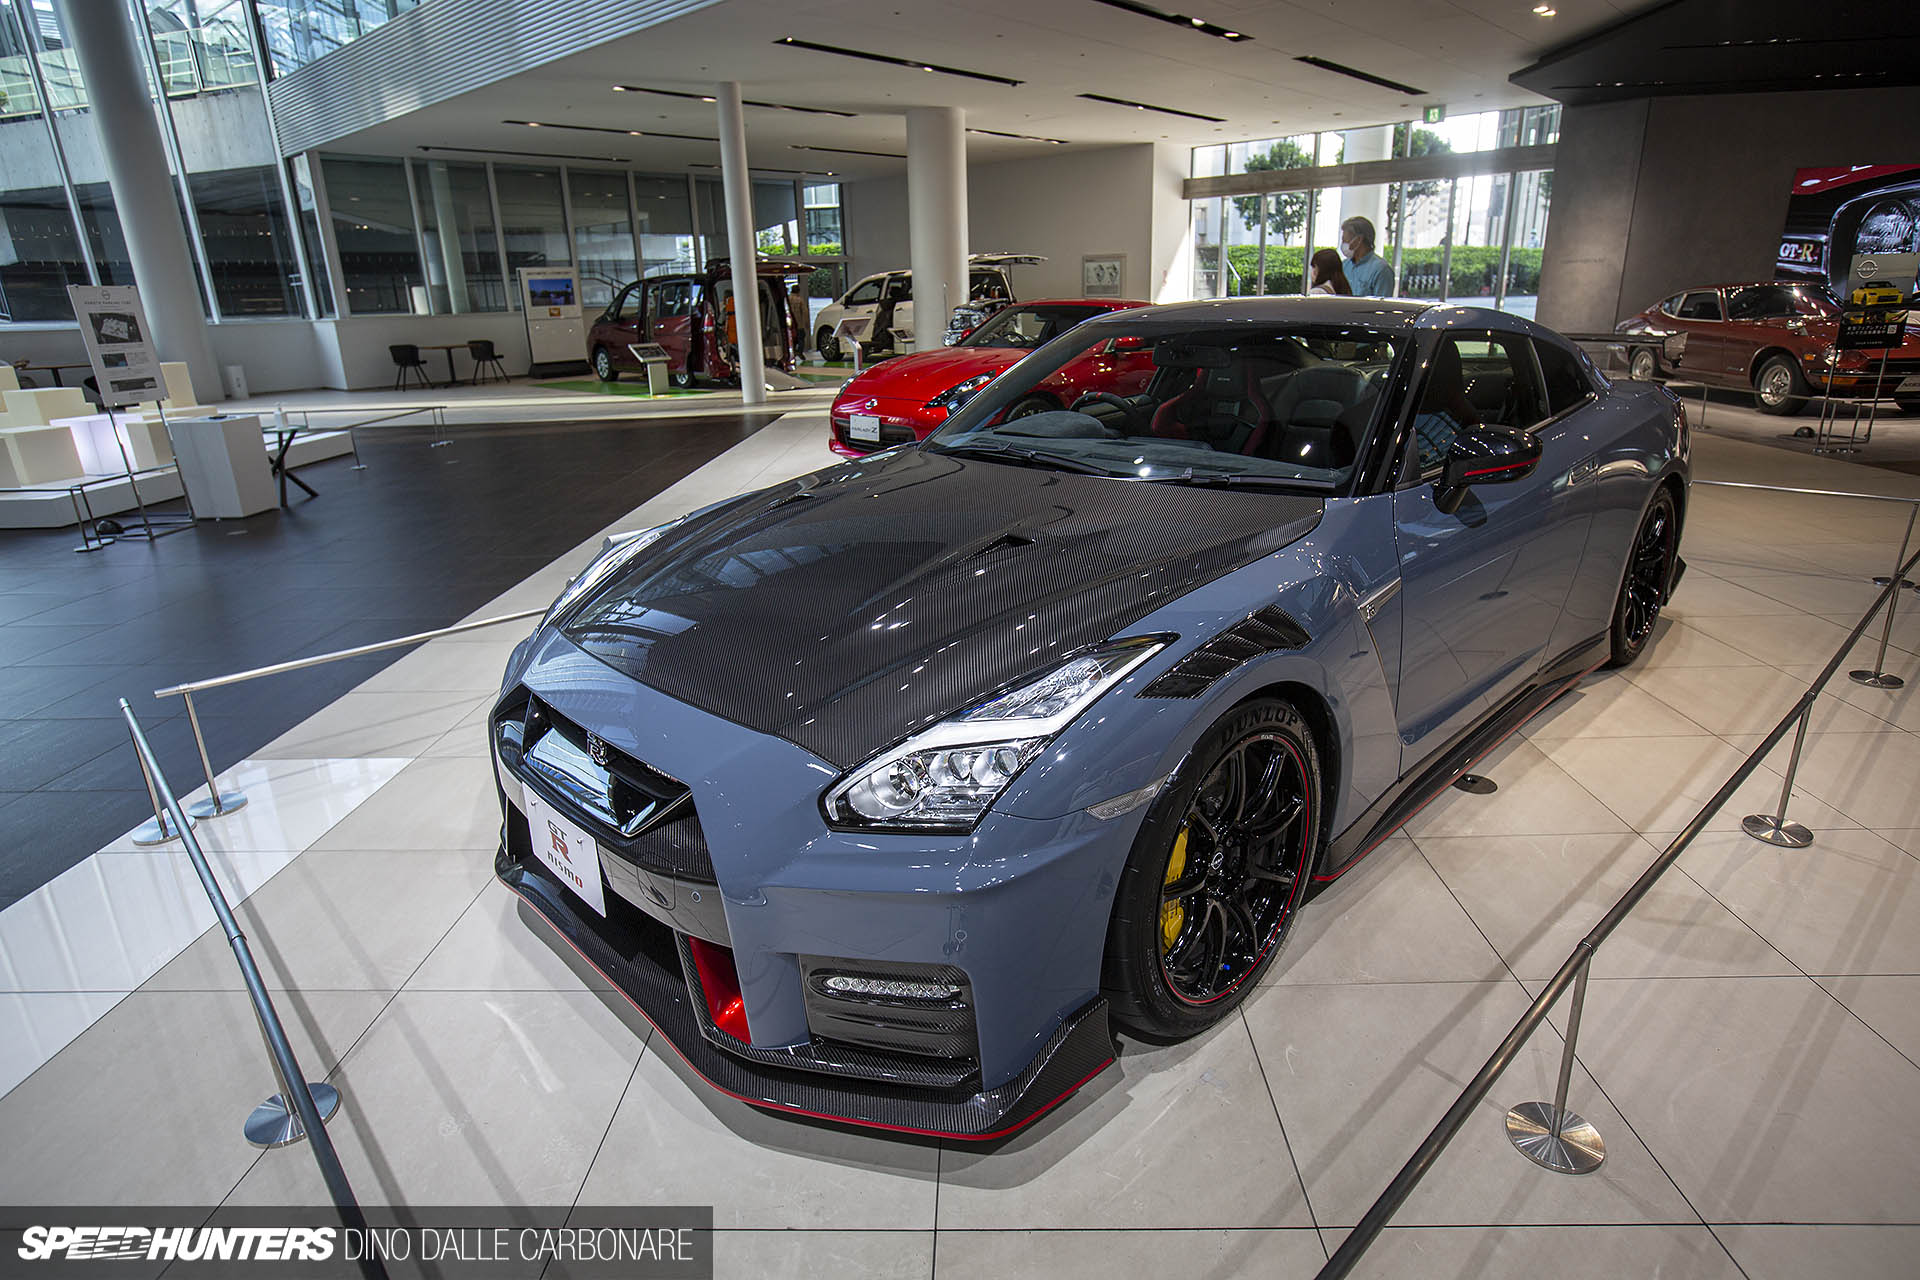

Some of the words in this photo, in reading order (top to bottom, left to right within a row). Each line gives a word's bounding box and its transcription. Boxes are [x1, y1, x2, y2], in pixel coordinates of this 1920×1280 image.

[1779, 242, 1814, 262] GT-R
[1220, 706, 1297, 745] DUNLOP
[547, 819, 568, 841] GT
[550, 830, 573, 865] R
